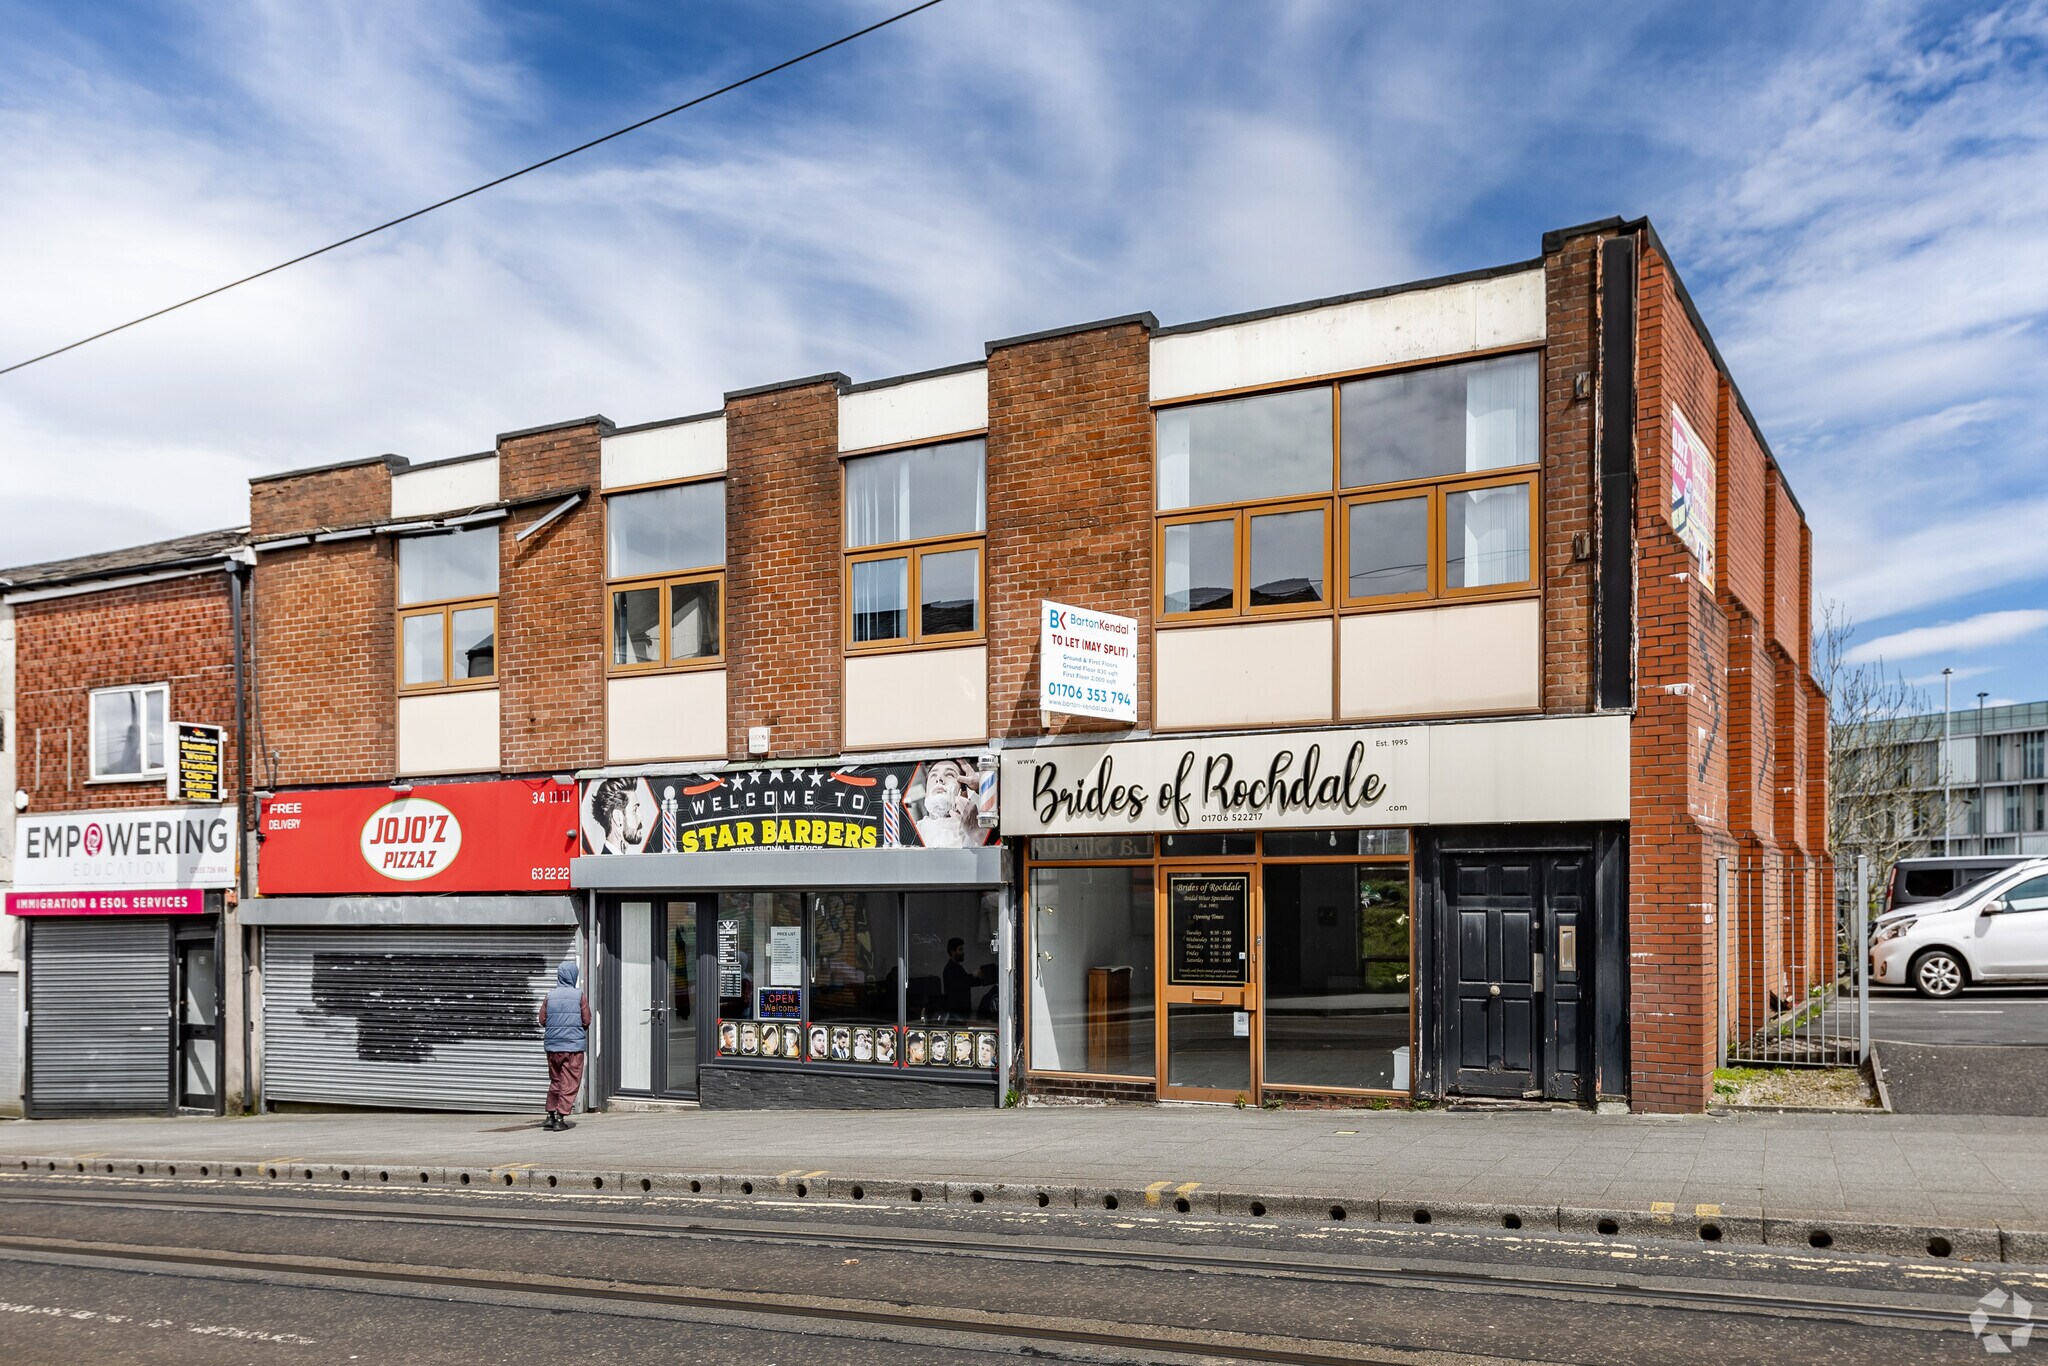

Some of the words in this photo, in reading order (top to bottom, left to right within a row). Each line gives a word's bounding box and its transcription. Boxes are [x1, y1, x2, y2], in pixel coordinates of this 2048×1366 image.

[1052, 634, 1063, 646] TO
[1065, 636, 1080, 649] LET
[1082, 639, 1102, 653] (MAY
[1103, 644, 1129, 658] SPLIT)
[1063, 654, 1082, 663] Ground
[1089, 658, 1101, 666] First
[1063, 662, 1081, 671] Ground
[1063, 671, 1075, 679] First
[1048, 682, 1083, 700] 01706
[1087, 688, 1107, 703] 353
[1111, 691, 1131, 706] 794
[1391, 738, 1409, 747] 1995
[1017, 758, 1038, 766] www.
[1031, 754, 1149, 825] Brides
[1158, 750, 1196, 826] of
[1203, 740, 1388, 813] Rochdale
[532, 791, 545, 804] 34
[549, 791, 558, 804] 11
[561, 790, 571, 803] 11
[692, 790, 815, 816] WELCOME
[835, 792, 865, 810] TO
[269, 802, 302, 815] FREE
[1385, 803, 1409, 813] .com
[1201, 813, 1230, 823] 01706
[1231, 812, 1264, 823] 522217
[268, 818, 301, 831] DELIVERY
[369, 814, 450, 845] JOJO'Z
[682, 821, 756, 853] STAR
[761, 819, 878, 849] BARBERS
[383, 850, 437, 869] PIZZAZ
[73, 861, 166, 877] EDUCATION
[531, 868, 544, 881] 63
[544, 867, 556, 880] 22
[557, 867, 570, 880] 22
[1200, 882, 1209, 892] of
[1209, 882, 1242, 891] Rochdale
[16, 897, 86, 909] IMMIGRATION
[89, 897, 97, 908] &
[100, 897, 128, 908] ESOL
[132, 896, 189, 908] SERVICES
[769, 994, 795, 1004] OPEN
[764, 1003, 799, 1013] Welcome
